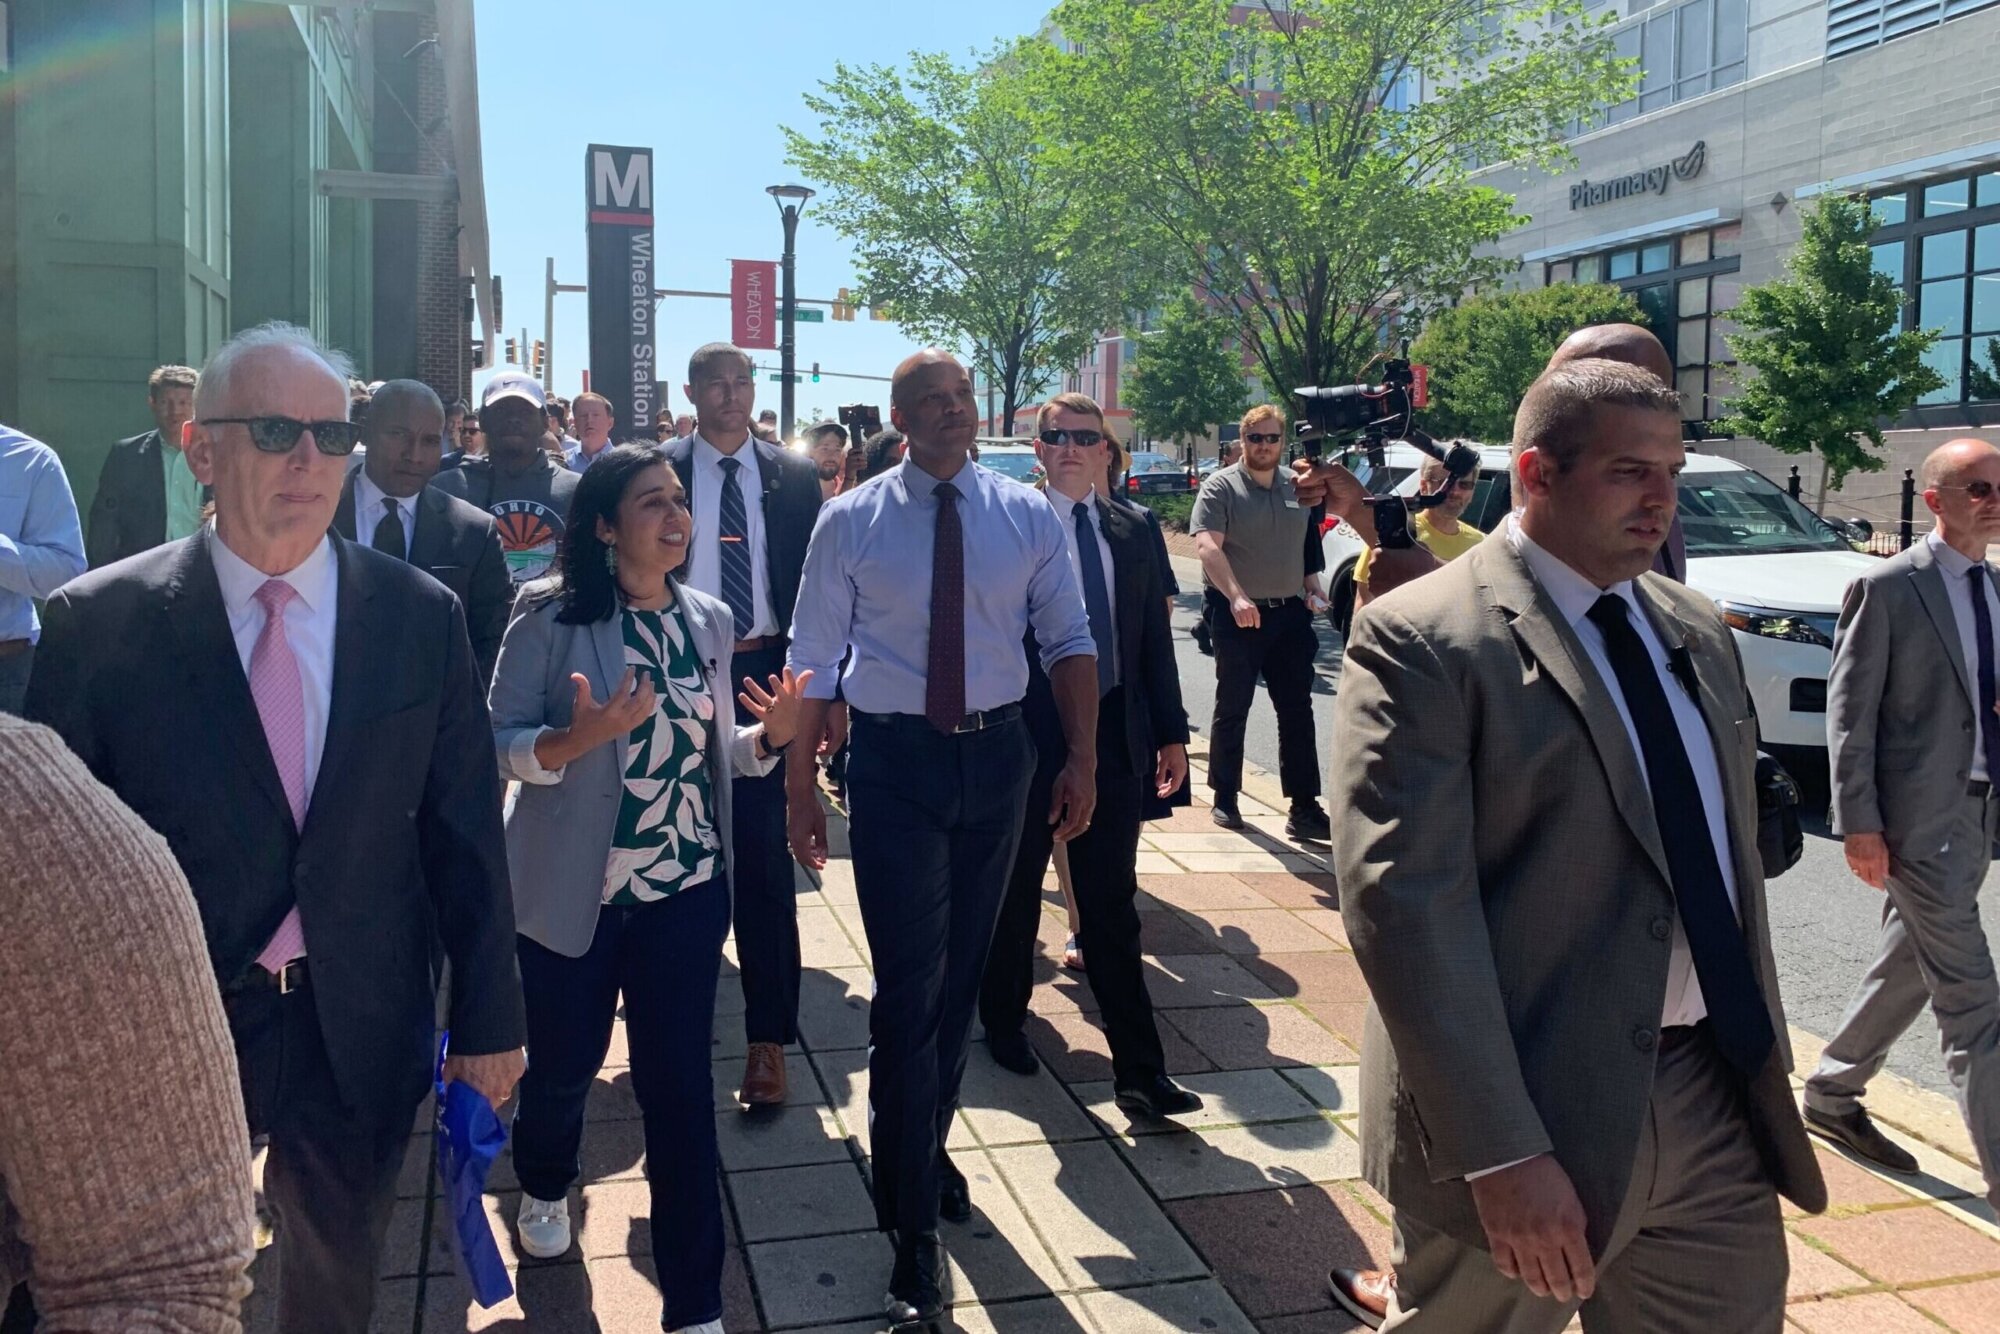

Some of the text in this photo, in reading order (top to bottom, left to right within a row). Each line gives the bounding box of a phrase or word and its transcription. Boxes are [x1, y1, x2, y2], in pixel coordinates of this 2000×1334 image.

[594, 151, 650, 208] M
[1569, 164, 1670, 211] Pharmacy
[631, 232, 653, 428] Wheaton Station
[746, 271, 762, 339] WHEATON
[494, 502, 545, 516] OHIO
